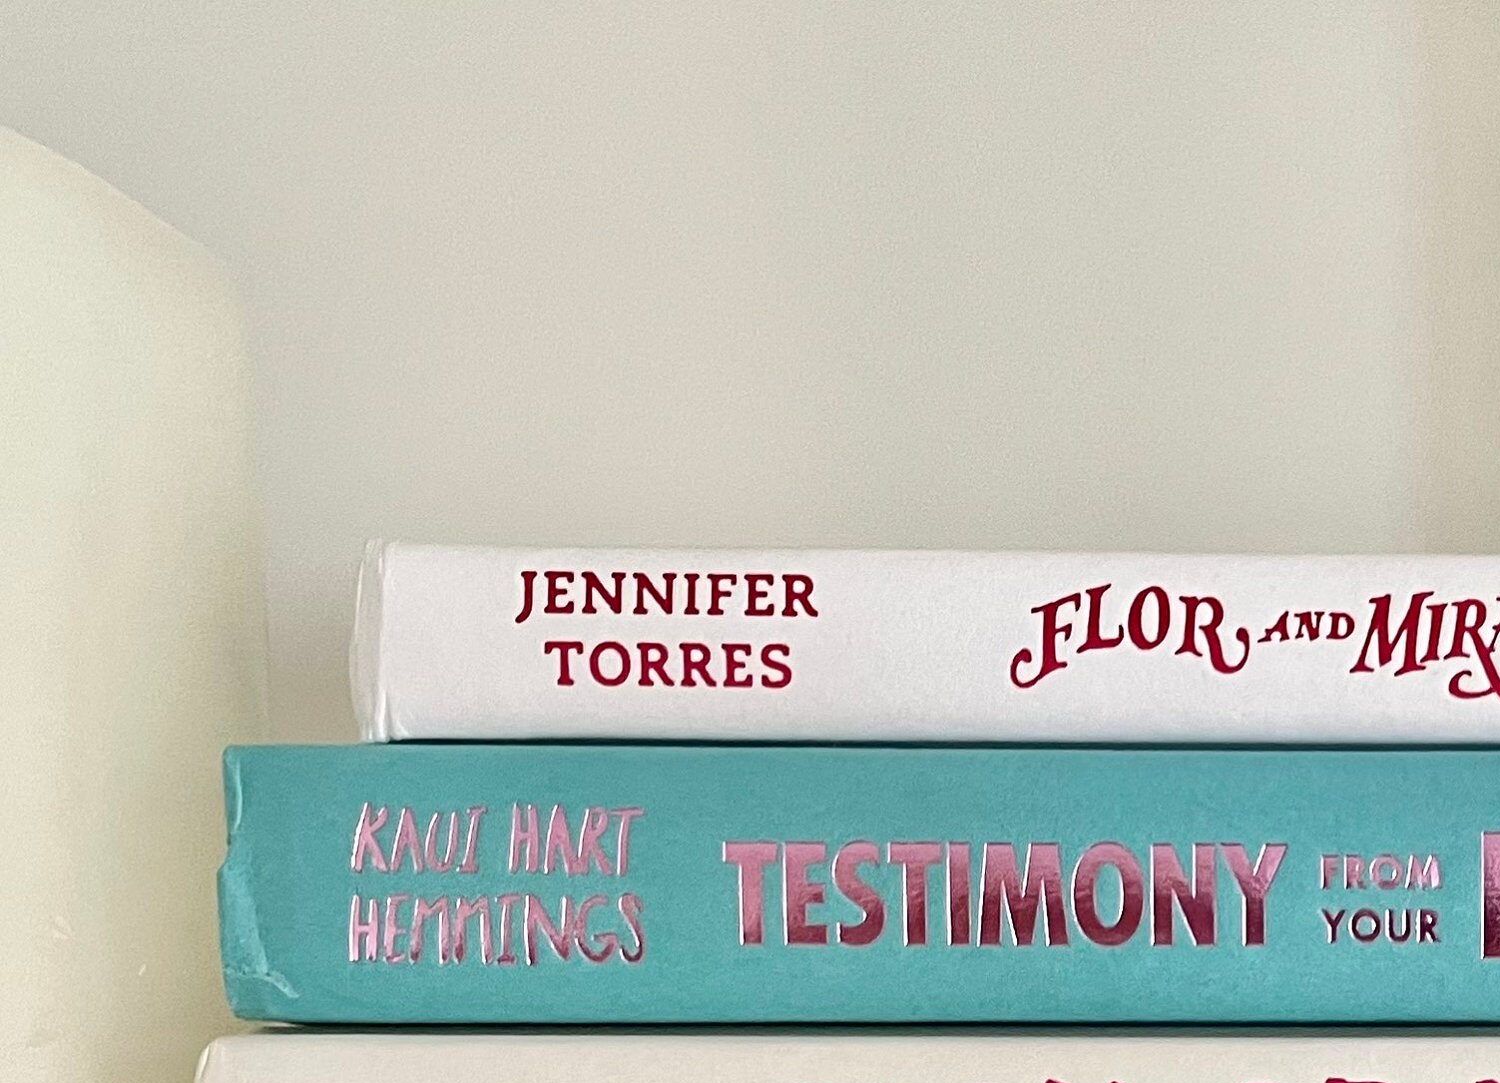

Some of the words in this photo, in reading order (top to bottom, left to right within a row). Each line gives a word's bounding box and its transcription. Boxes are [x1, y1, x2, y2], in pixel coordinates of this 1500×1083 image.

[515, 571, 818, 623] JENNIFER
[544, 641, 792, 688] TORRES
[1010, 583, 1250, 688] FLOR
[1257, 609, 1356, 642] AND
[350, 802, 485, 874] KAUI
[507, 802, 643, 876] HART
[723, 840, 1288, 947] TESTIMONY
[1320, 853, 1443, 891] FROM
[347, 892, 645, 967] HEMMINGS
[1323, 908, 1441, 945] YOUR
